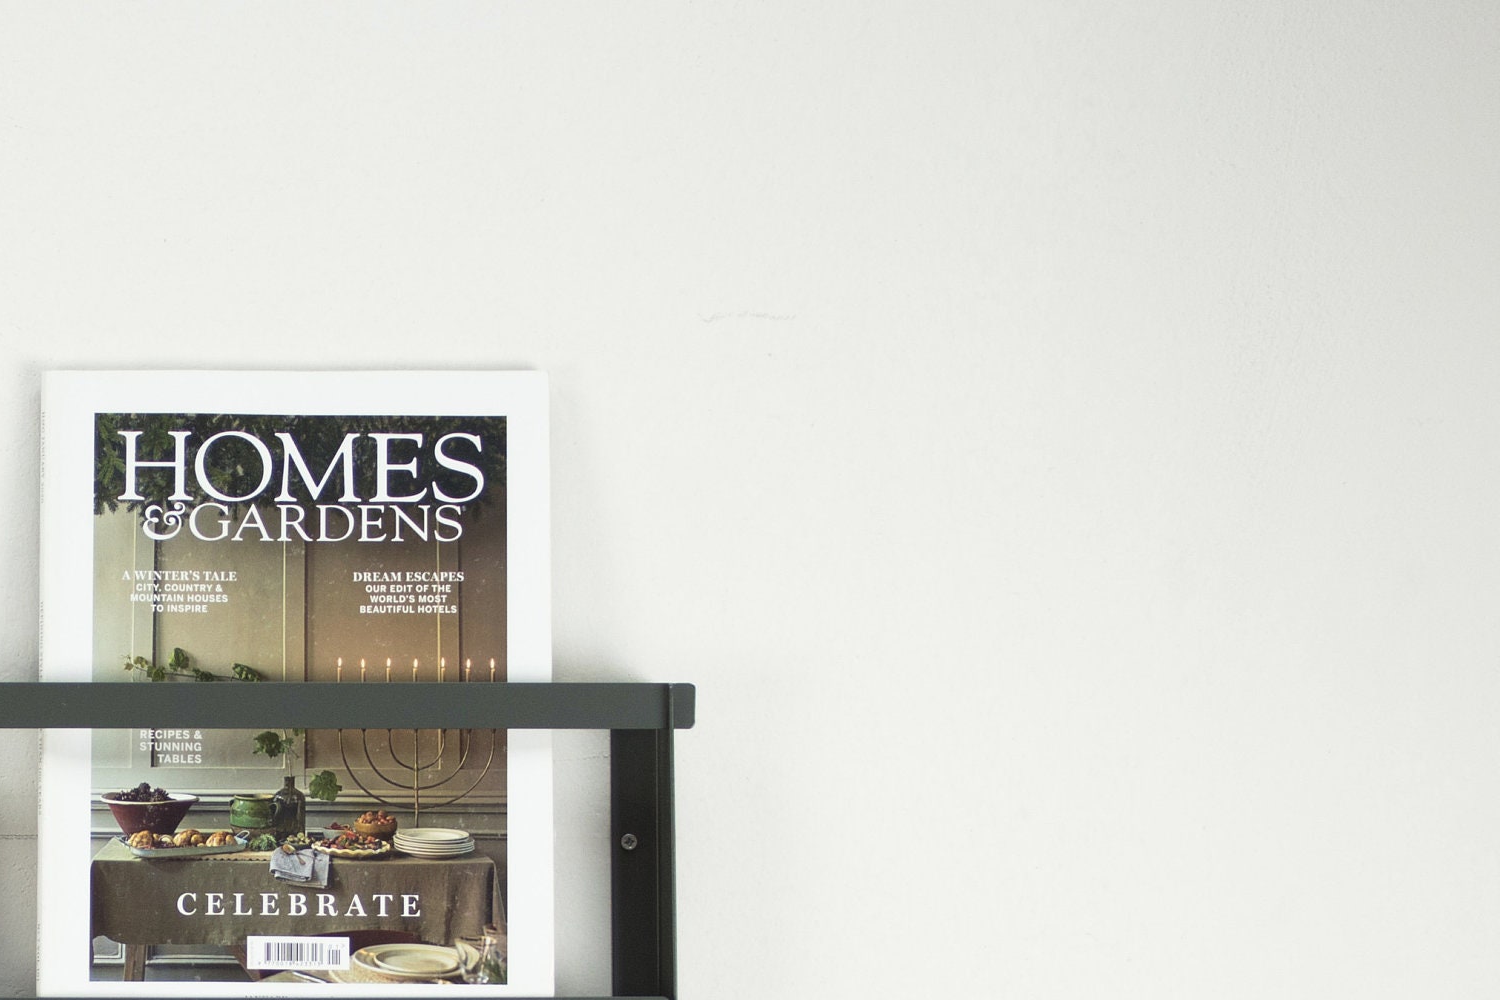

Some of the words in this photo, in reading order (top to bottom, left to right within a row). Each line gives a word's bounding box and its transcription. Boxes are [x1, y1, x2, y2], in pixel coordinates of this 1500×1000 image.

[116, 430, 485, 504] HOMES
[122, 570, 131, 580] A
[134, 570, 200, 581] WINTER'S
[203, 571, 237, 581] TALE
[353, 572, 401, 581] DREAM
[405, 572, 464, 582] ESCAPES
[135, 583, 162, 592] CITY,
[164, 584, 212, 592] COUNTRY
[365, 585, 386, 593] OUR
[389, 584, 412, 593] EDIT
[415, 584, 429, 593] OF
[431, 584, 451, 593] THE
[129, 593, 183, 603] MOUNTAIN
[186, 594, 228, 602] HOUSES
[369, 595, 415, 603] WORLD'S
[418, 594, 447, 603] MOST
[166, 604, 207, 613] INSPIRE
[359, 605, 415, 613] BEAUTIFUL
[417, 605, 457, 614] HOTELS
[139, 729, 189, 739] RECIPES
[193, 730, 202, 739] &
[139, 741, 201, 751] STUNNING
[157, 754, 201, 763] TABLES
[177, 893, 420, 916] CELEBRATE
